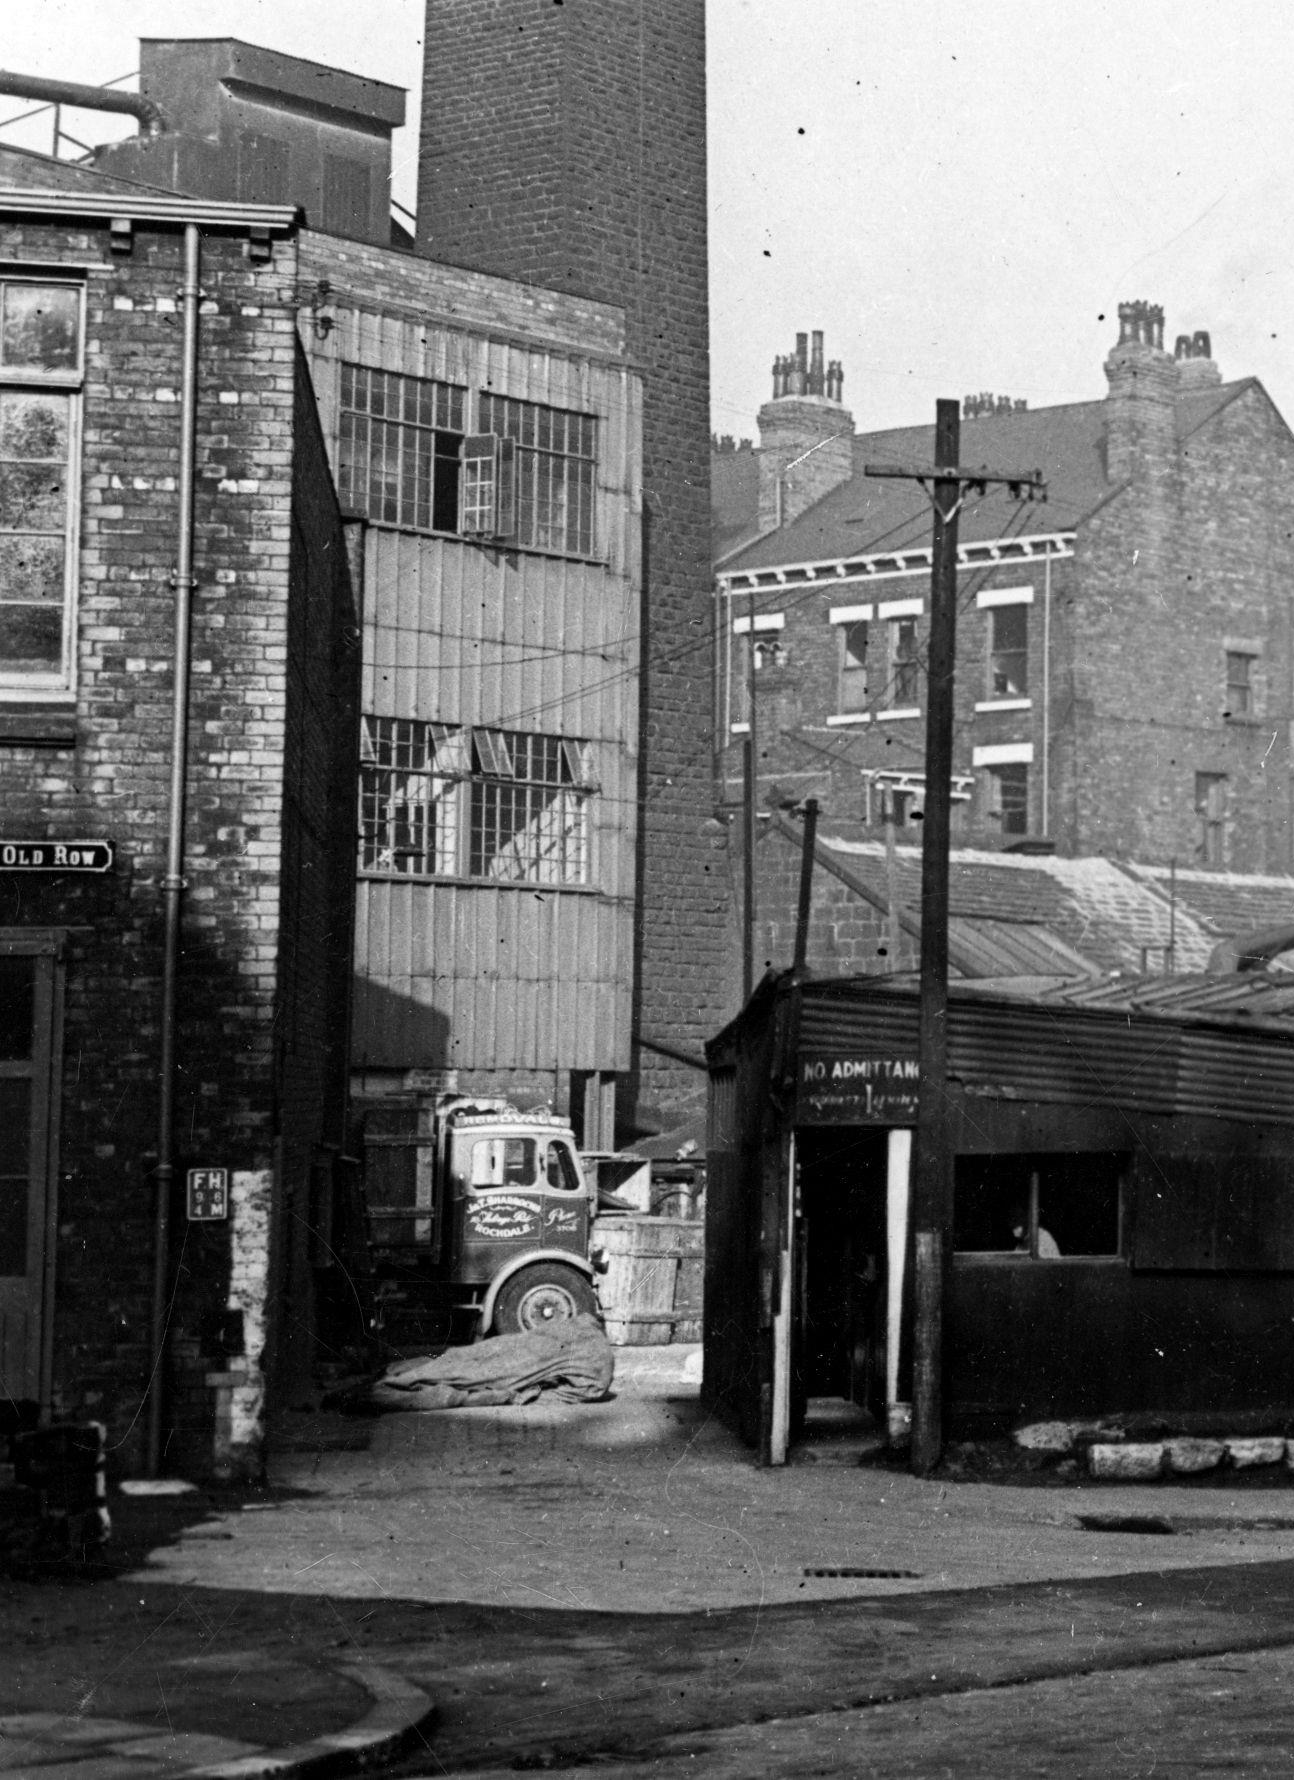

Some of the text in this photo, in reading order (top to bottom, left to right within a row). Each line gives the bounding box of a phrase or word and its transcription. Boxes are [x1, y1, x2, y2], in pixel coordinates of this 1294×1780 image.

[3, 845, 96, 865] OLD ROW
[804, 1061, 826, 1081] NO
